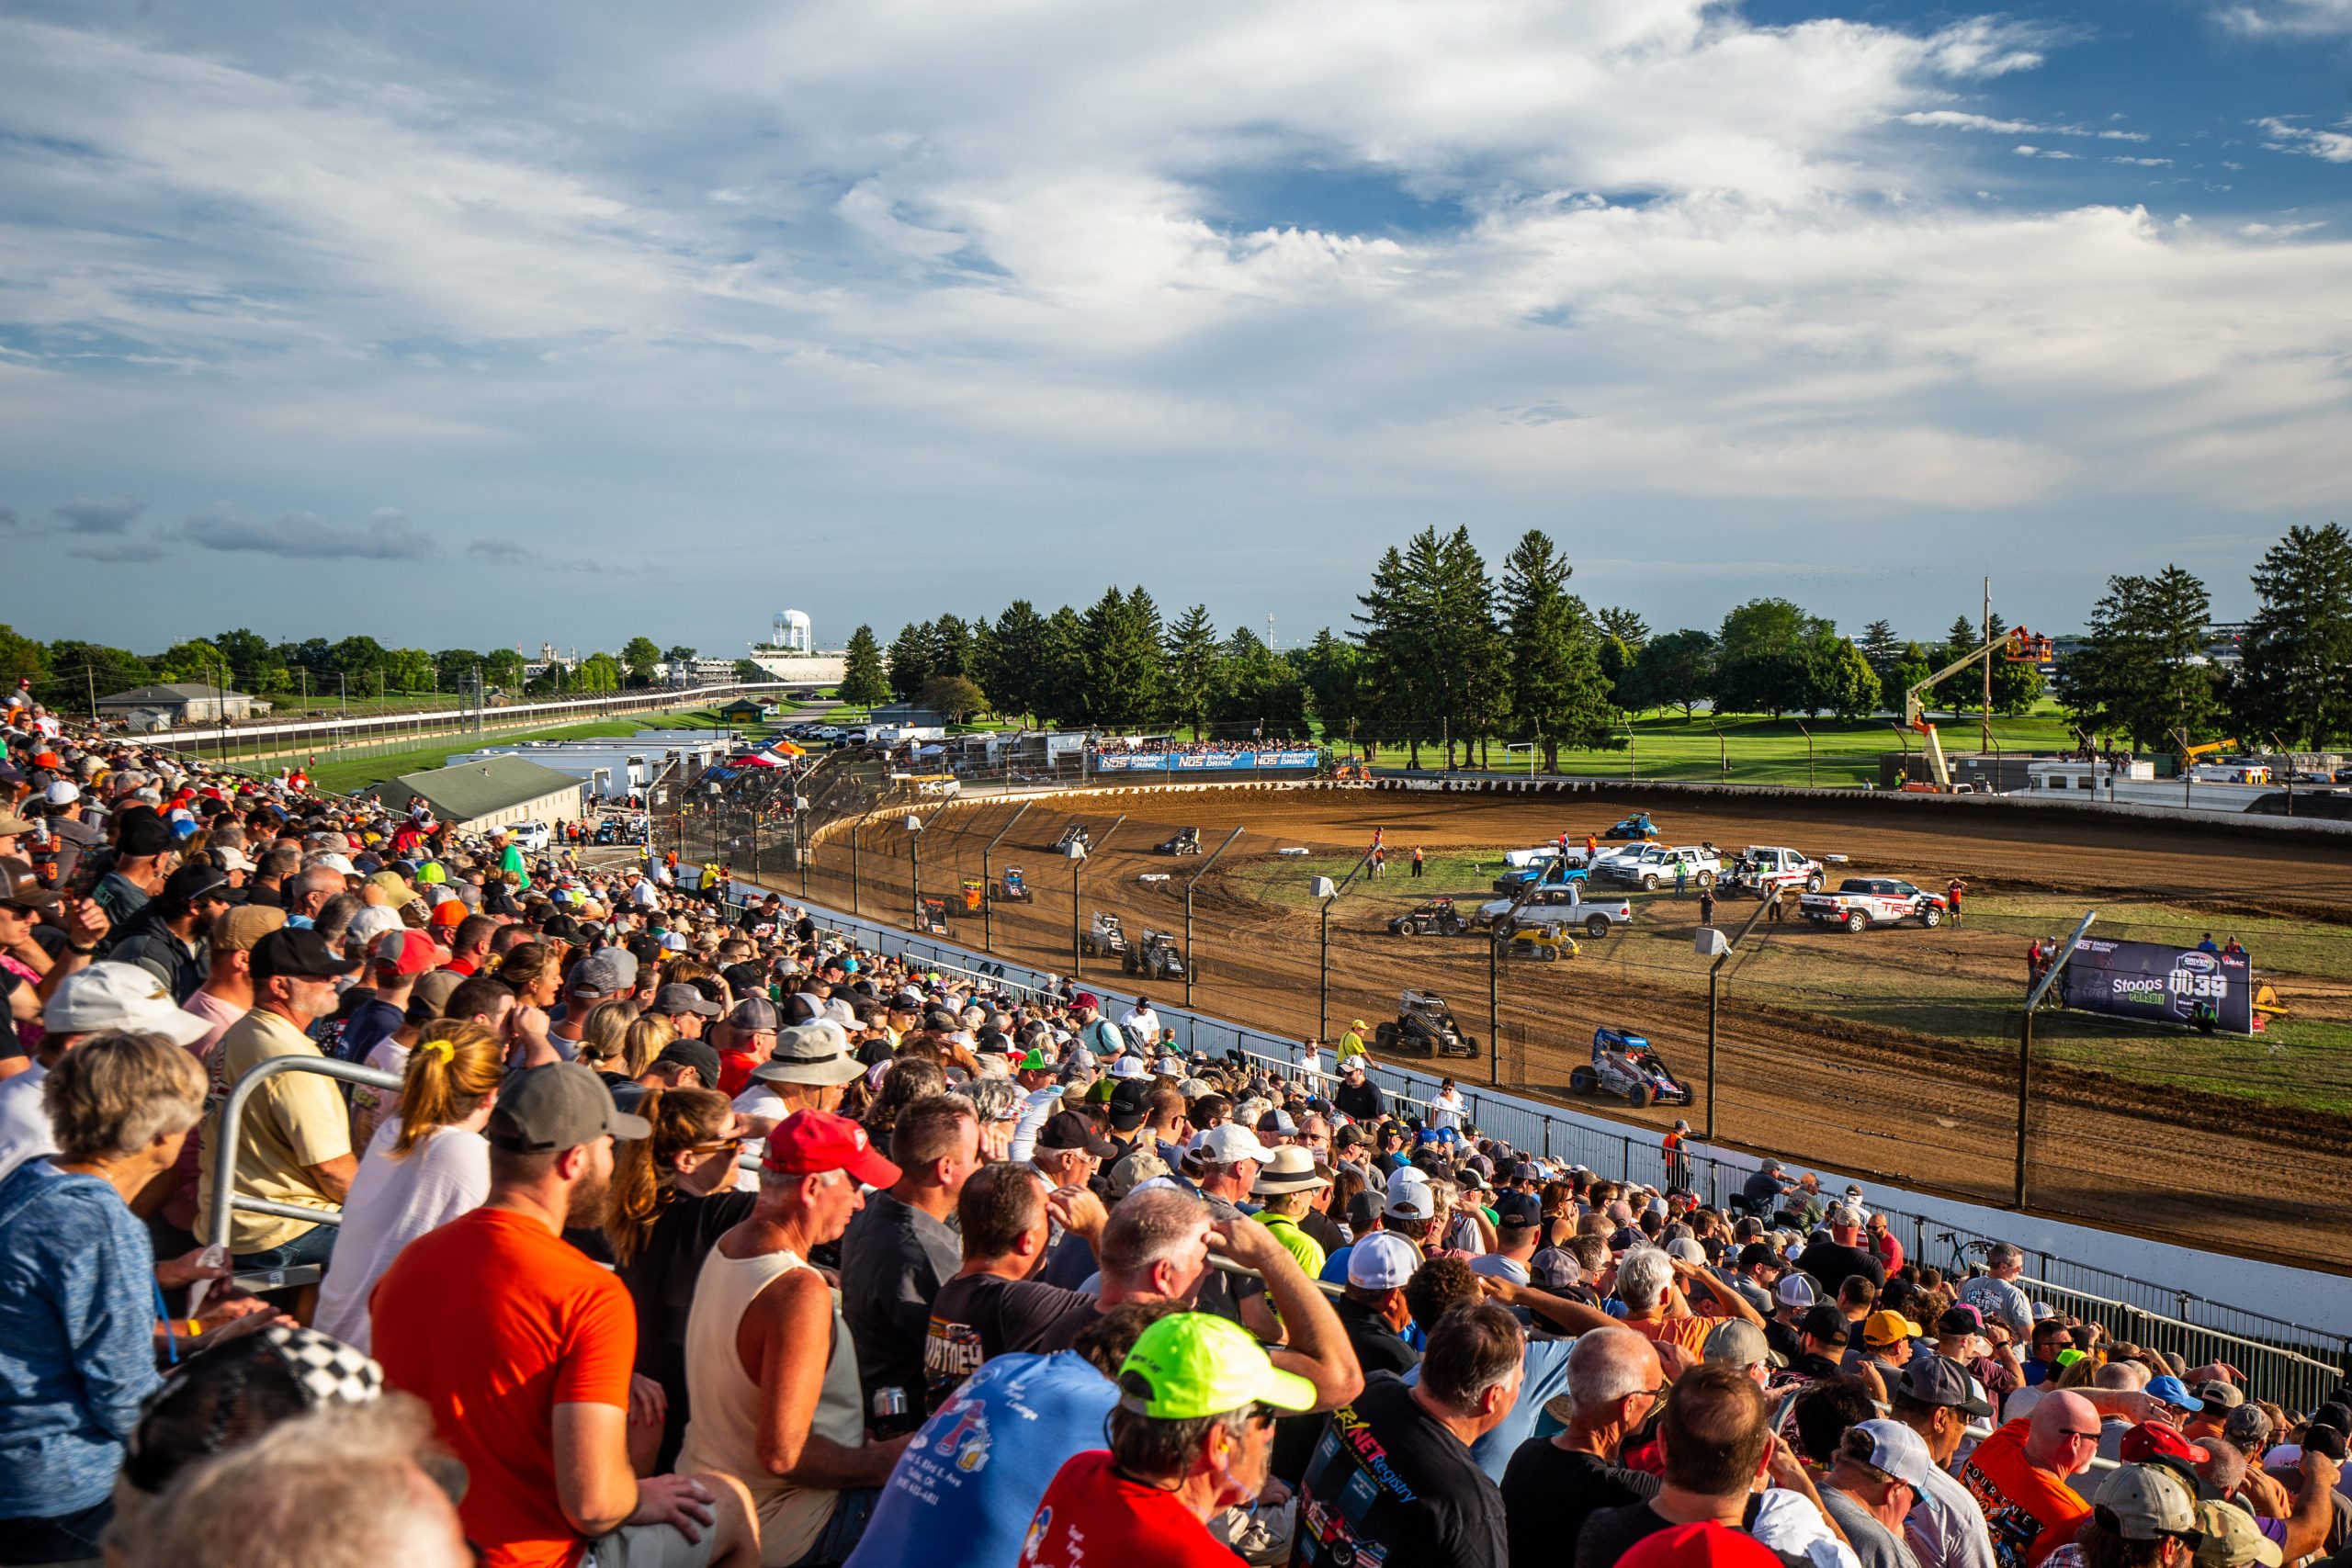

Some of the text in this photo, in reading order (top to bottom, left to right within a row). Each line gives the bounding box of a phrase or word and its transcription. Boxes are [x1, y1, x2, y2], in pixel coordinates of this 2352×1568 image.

[1102, 756, 1130, 768] NOS
[1179, 755, 1205, 767] NOS
[1253, 753, 1281, 766] NOS
[1881, 901, 1915, 915] TRD
[2091, 945, 2111, 953] DRINK
[2092, 940, 2119, 950] ENERGY
[2224, 958, 2245, 967] USAC
[2112, 977, 2163, 994] Stoops
[2129, 991, 2165, 1005] PURSUIT
[1005, 1399, 1038, 1421] Lounge
[944, 1472, 962, 1488] Ave
[1966, 1460, 2045, 1534] COURTNEY
